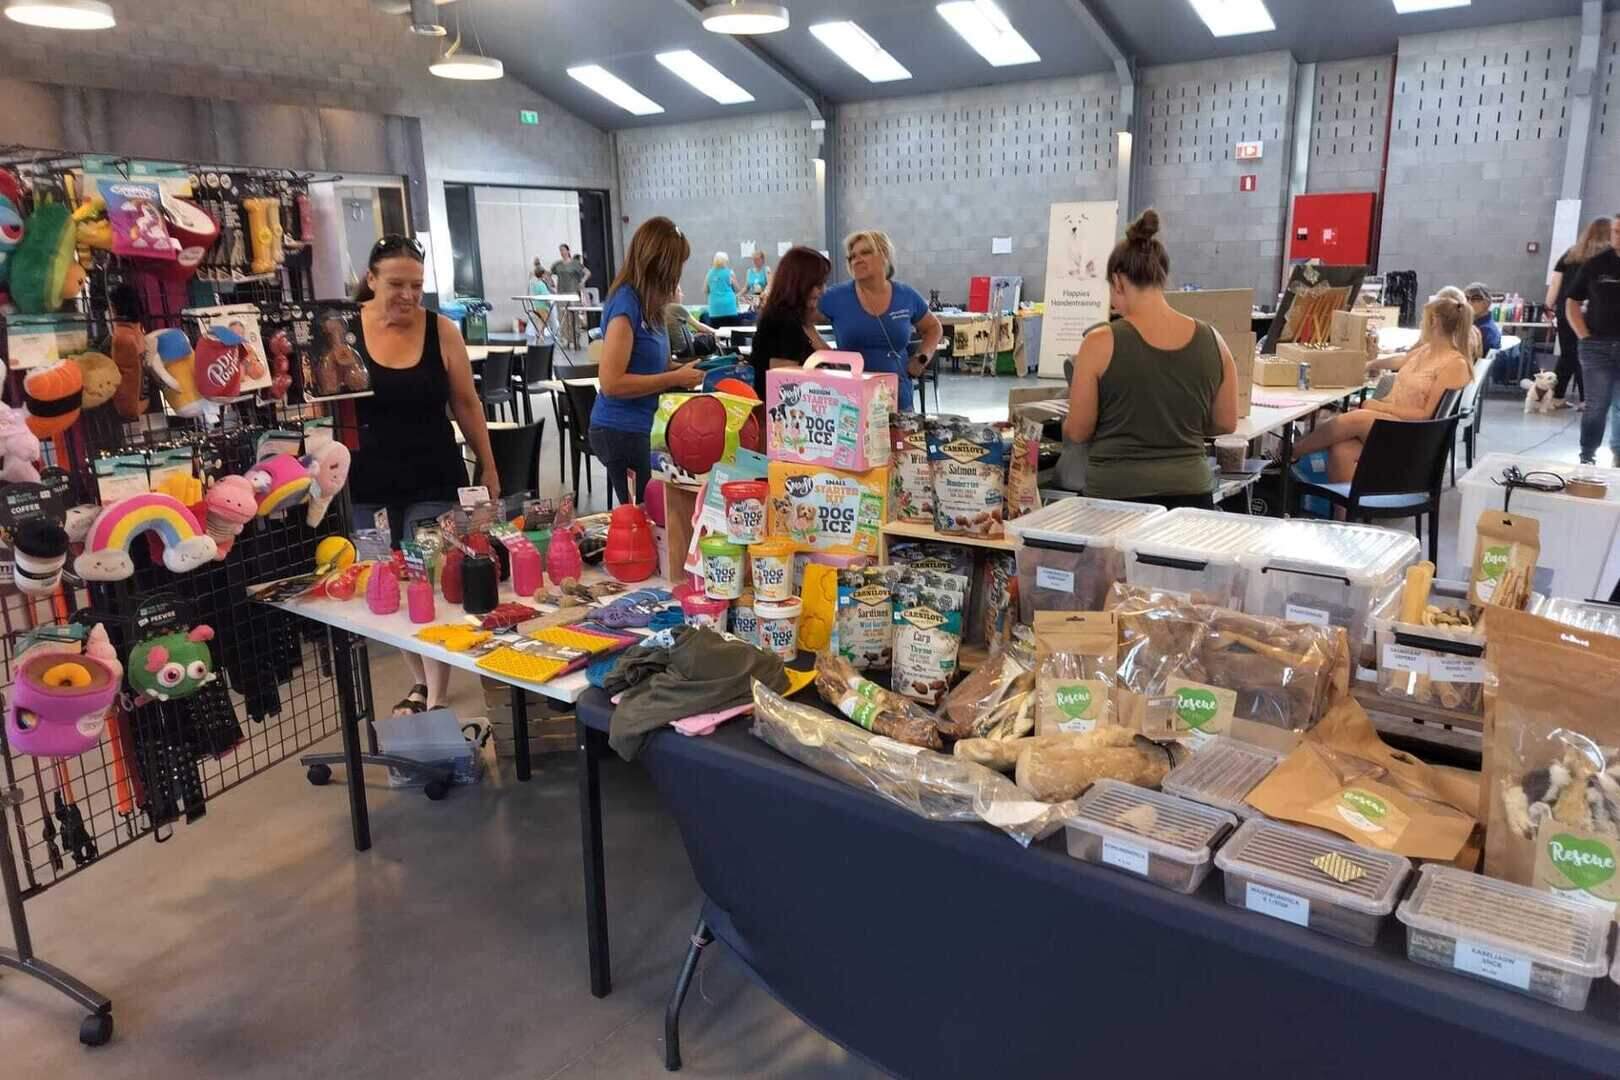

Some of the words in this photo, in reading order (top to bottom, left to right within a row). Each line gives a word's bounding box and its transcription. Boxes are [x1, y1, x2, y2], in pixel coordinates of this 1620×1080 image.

[809, 388, 831, 396] MEDIUM
[803, 394, 840, 406] STARTER
[806, 415, 835, 433] DOG
[808, 430, 833, 446] ICE
[943, 445, 984, 455] CARNILOVE
[948, 463, 977, 476] Salmon
[816, 485, 859, 496] STARTER
[11, 503, 40, 515] COFFEE
[818, 506, 855, 521] DOG
[743, 511, 763, 520] DOG
[744, 518, 761, 528] ICE
[822, 520, 851, 534] ICE
[715, 567, 736, 577] DOG
[763, 567, 784, 577] DOG
[716, 575, 735, 583] ICE
[764, 576, 782, 585] ICE
[853, 589, 892, 597] CARNILOVE
[904, 610, 943, 622] CARNILOVE
[772, 629, 793, 640] DOG
[913, 631, 930, 644] Carp
[774, 637, 790, 647] ICE
[1056, 691, 1090, 706] Rescue
[1177, 694, 1216, 710] Rescue
[1549, 841, 1616, 869] Rescue
